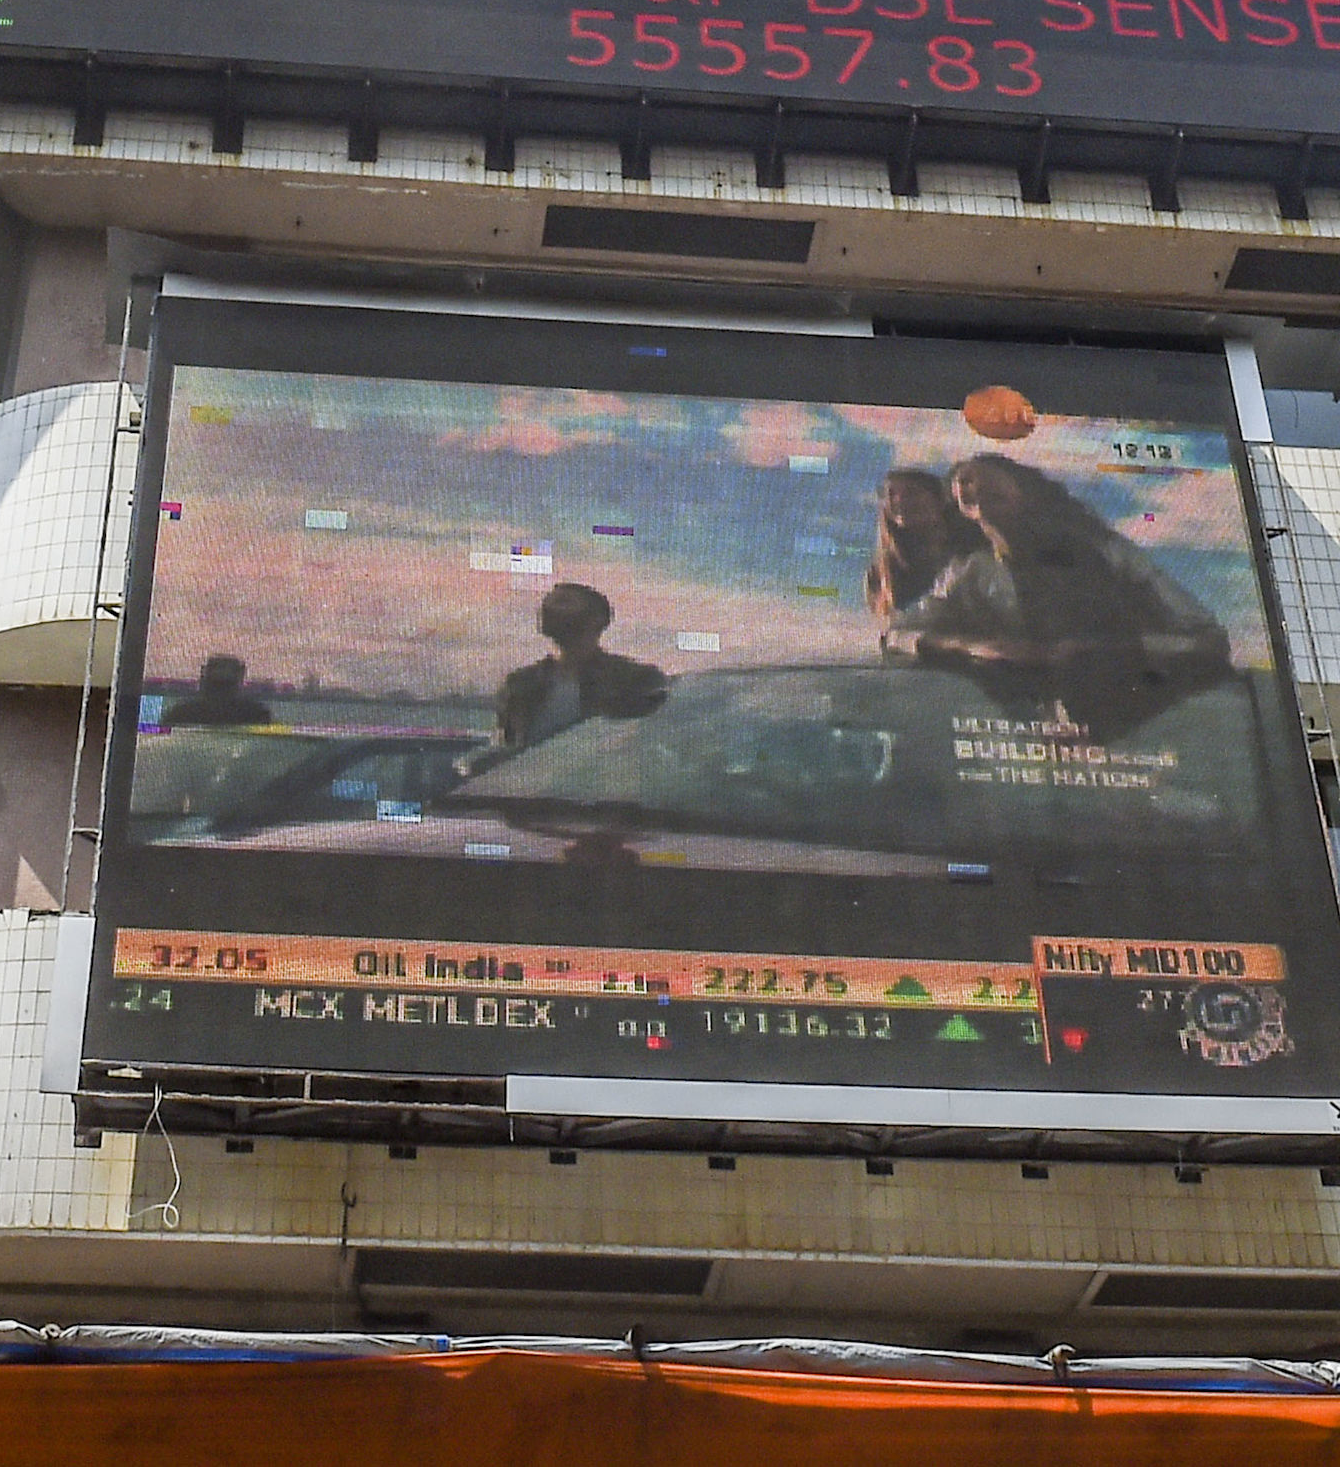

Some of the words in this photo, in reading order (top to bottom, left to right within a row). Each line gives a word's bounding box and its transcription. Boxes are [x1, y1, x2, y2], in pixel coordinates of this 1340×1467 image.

[565, 9, 1046, 99] 55557.83
[954, 739, 1107, 764] BUILDING
[254, 988, 344, 1020] MCX
[363, 993, 557, 1029] METLDEX
